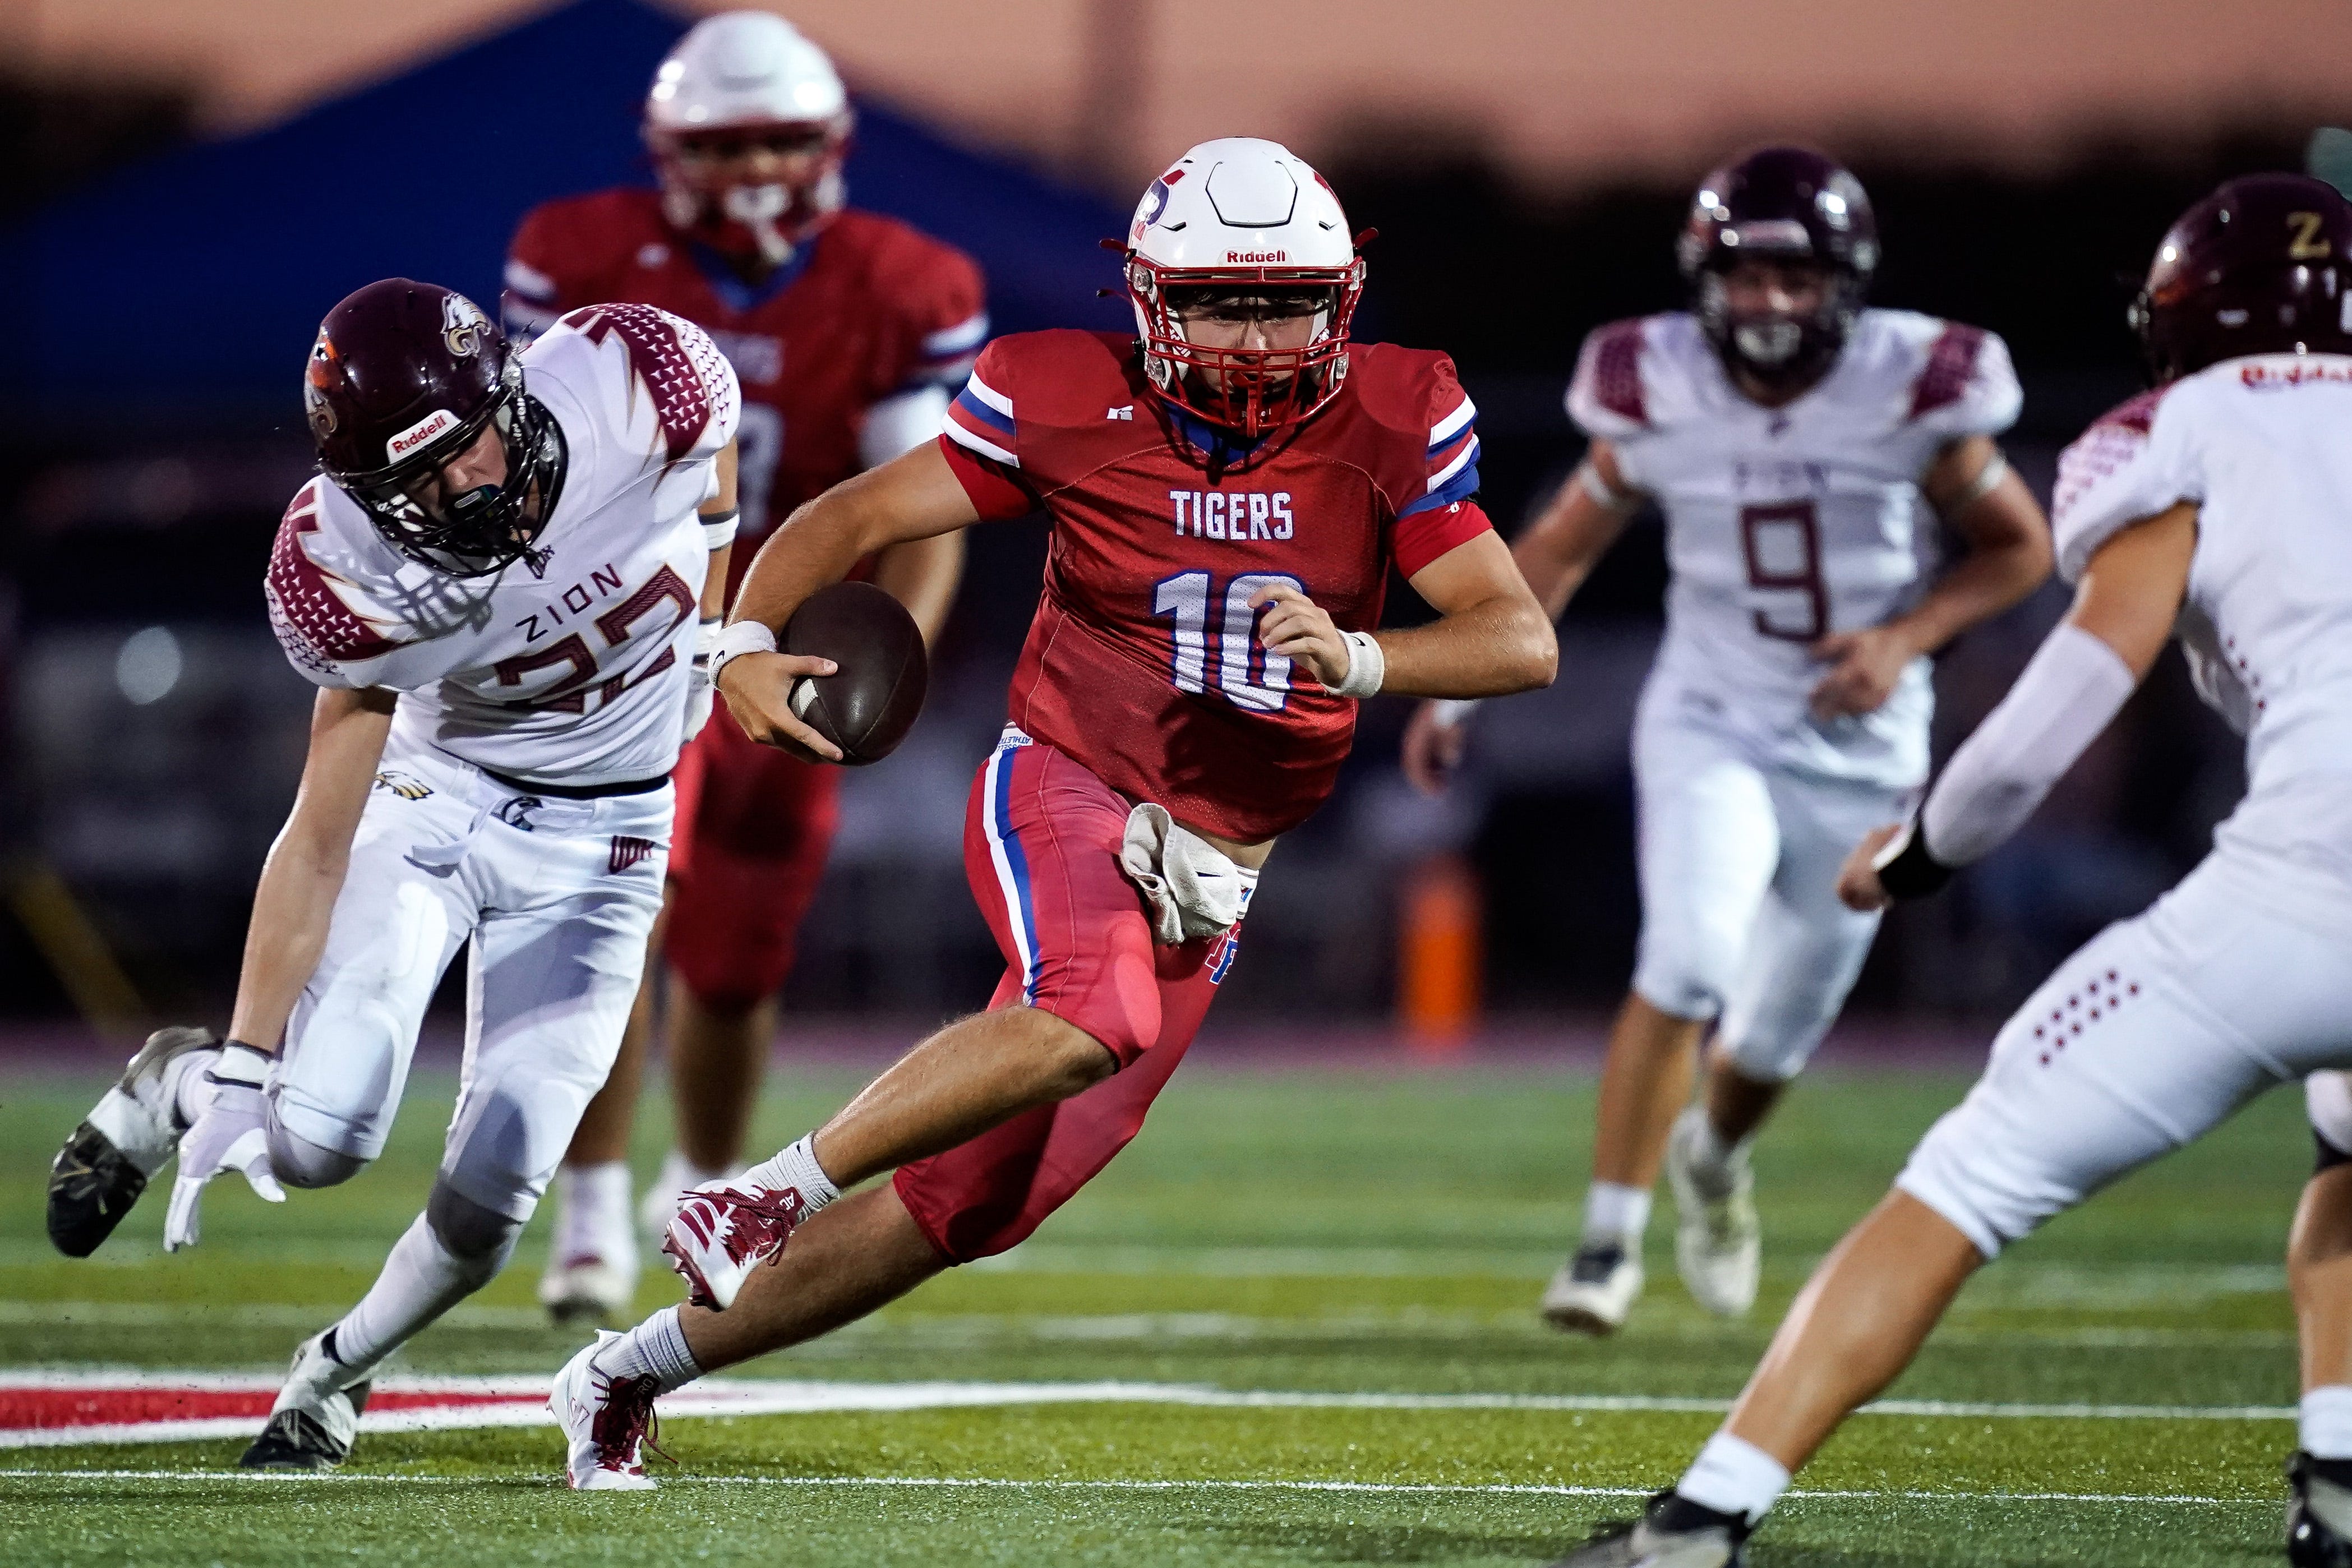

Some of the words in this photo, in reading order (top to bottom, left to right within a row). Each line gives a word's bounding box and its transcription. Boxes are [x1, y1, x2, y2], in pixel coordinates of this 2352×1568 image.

[1227, 249, 1286, 262] Riddell
[2287, 211, 2331, 260] Z
[391, 414, 447, 454] Riddell
[1169, 490, 1294, 540] TIGERS
[515, 562, 623, 643] ZION
[1739, 497, 1830, 643] 9
[494, 562, 697, 714] 22
[1154, 571, 1305, 711] 10
